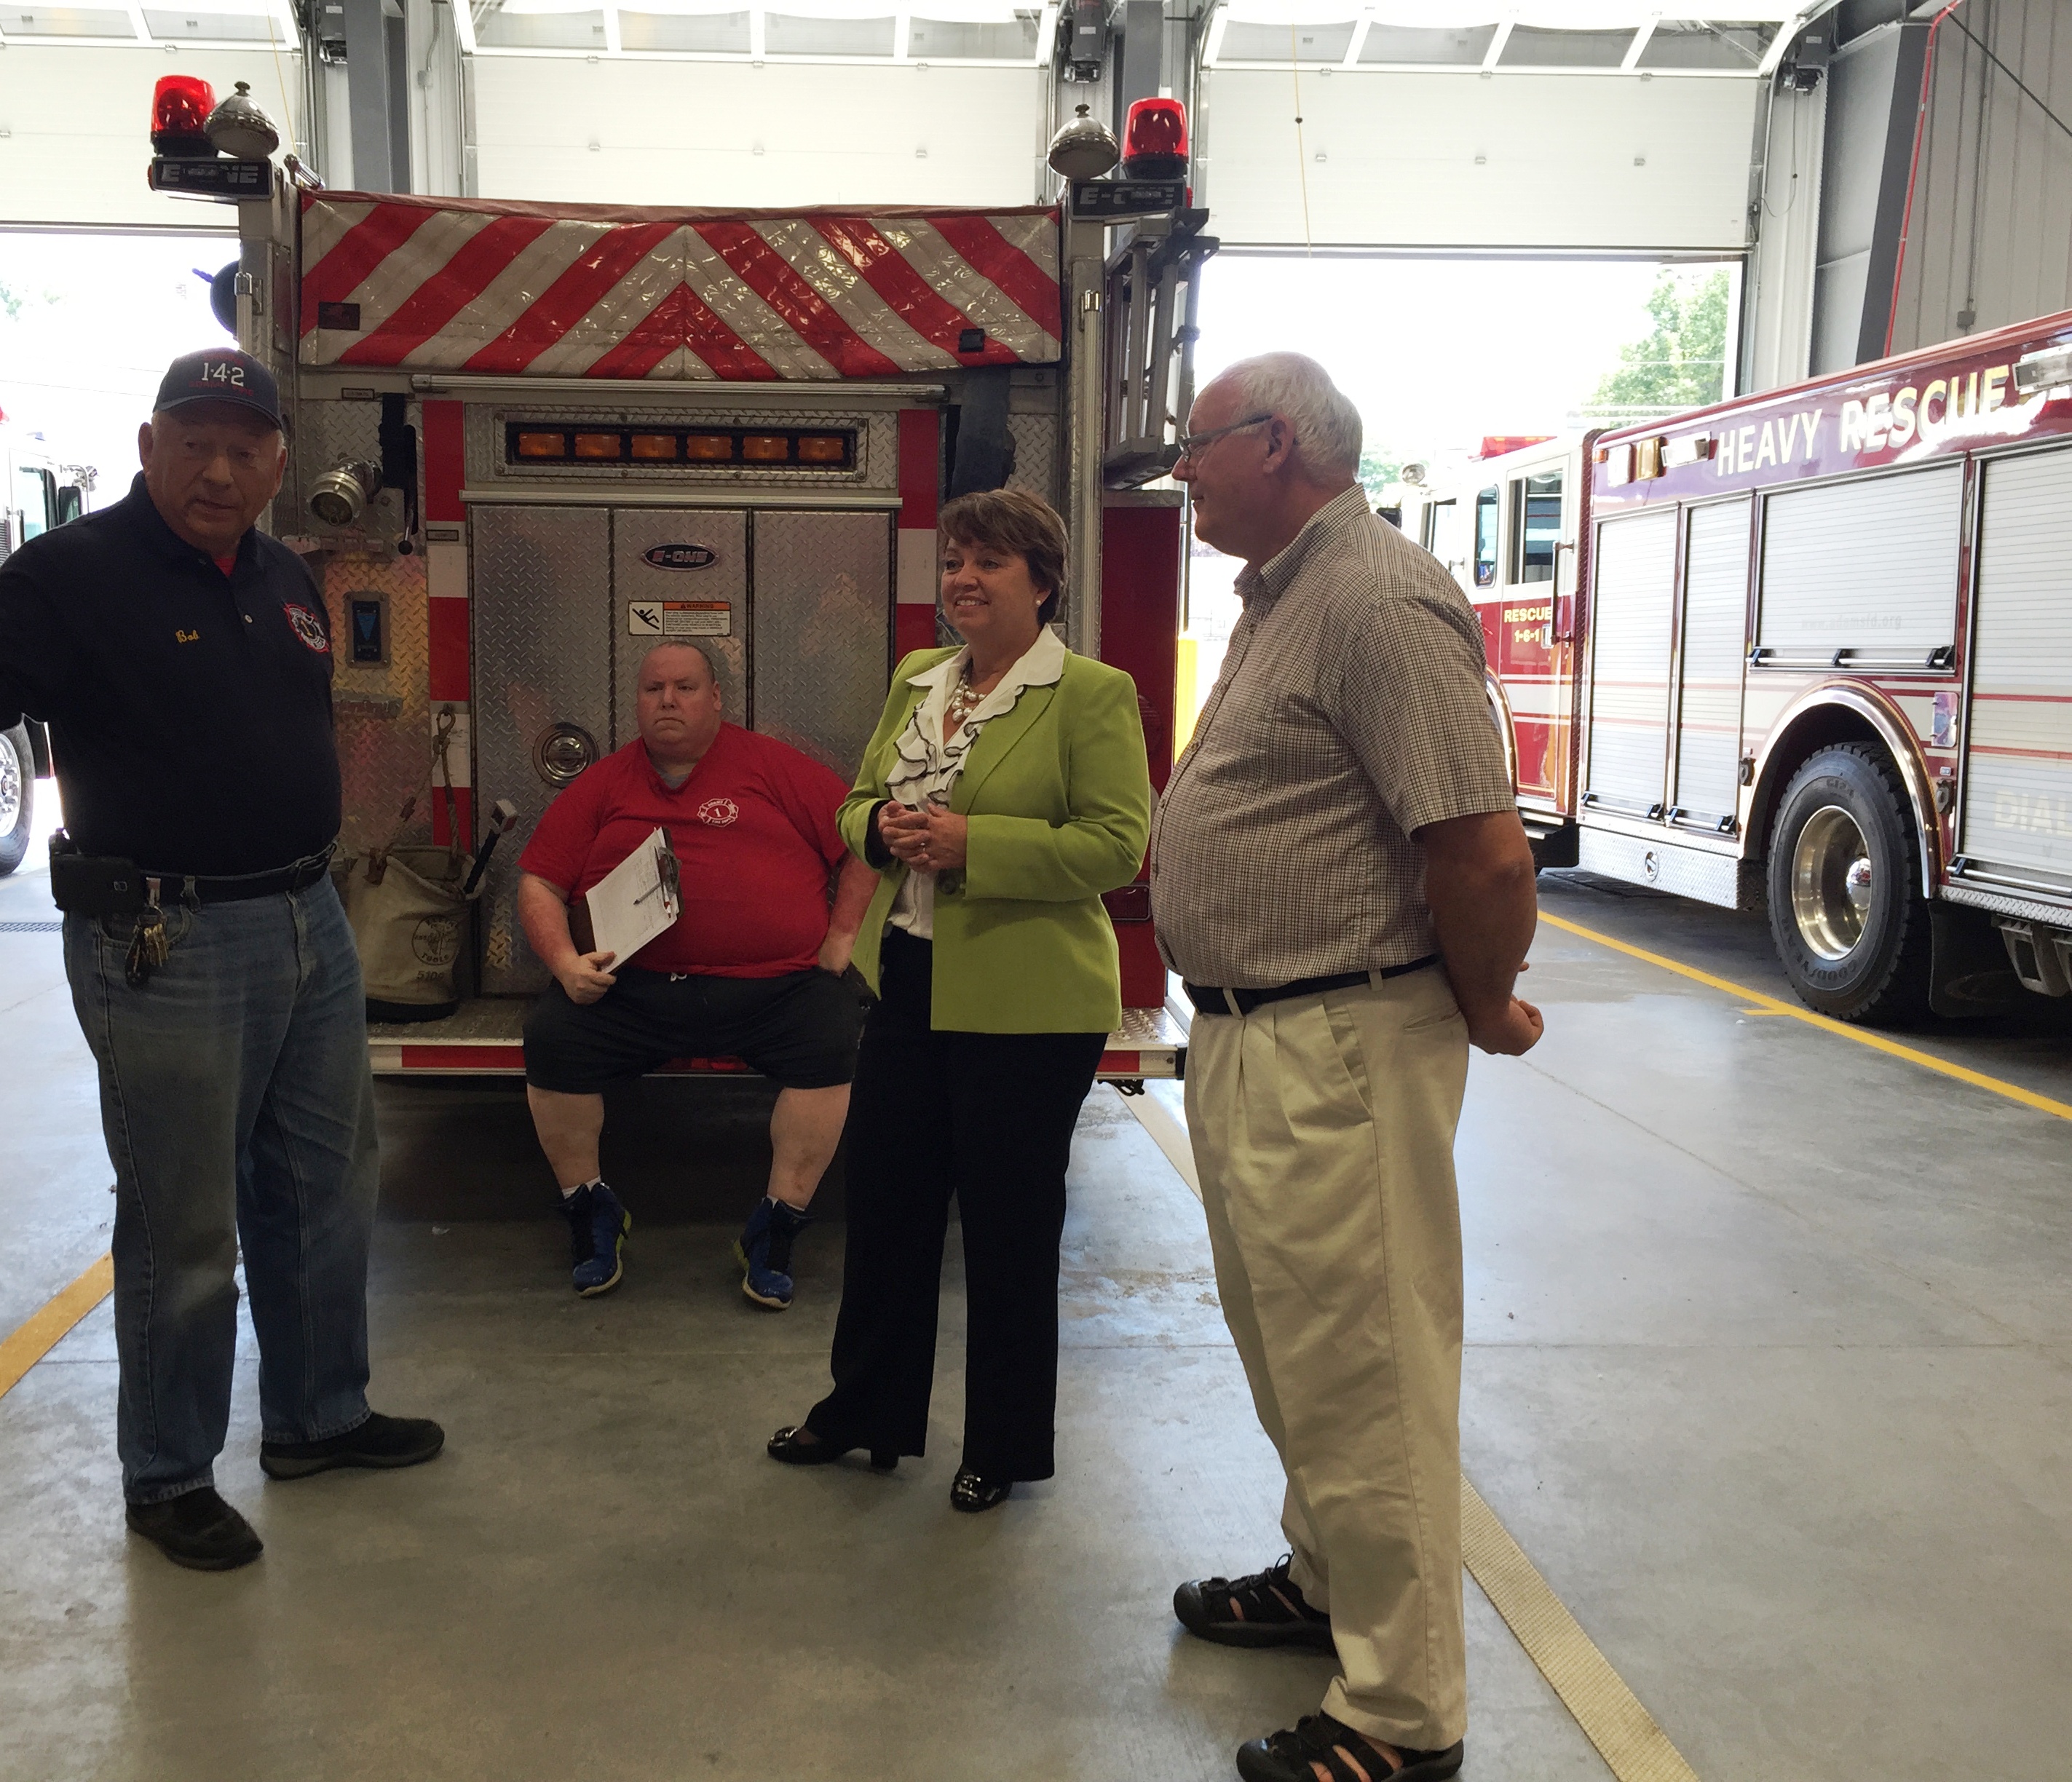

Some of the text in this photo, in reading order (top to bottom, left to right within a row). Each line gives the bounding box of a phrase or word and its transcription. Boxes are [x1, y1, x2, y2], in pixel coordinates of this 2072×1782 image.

[1717, 408, 1823, 478] HEAVY
[1840, 365, 2010, 454] RESCUE
[652, 550, 708, 563] E-ONE
[1503, 606, 1551, 623] RESCUE
[713, 807, 722, 817] 1
[1994, 789, 2072, 837] DIAL
